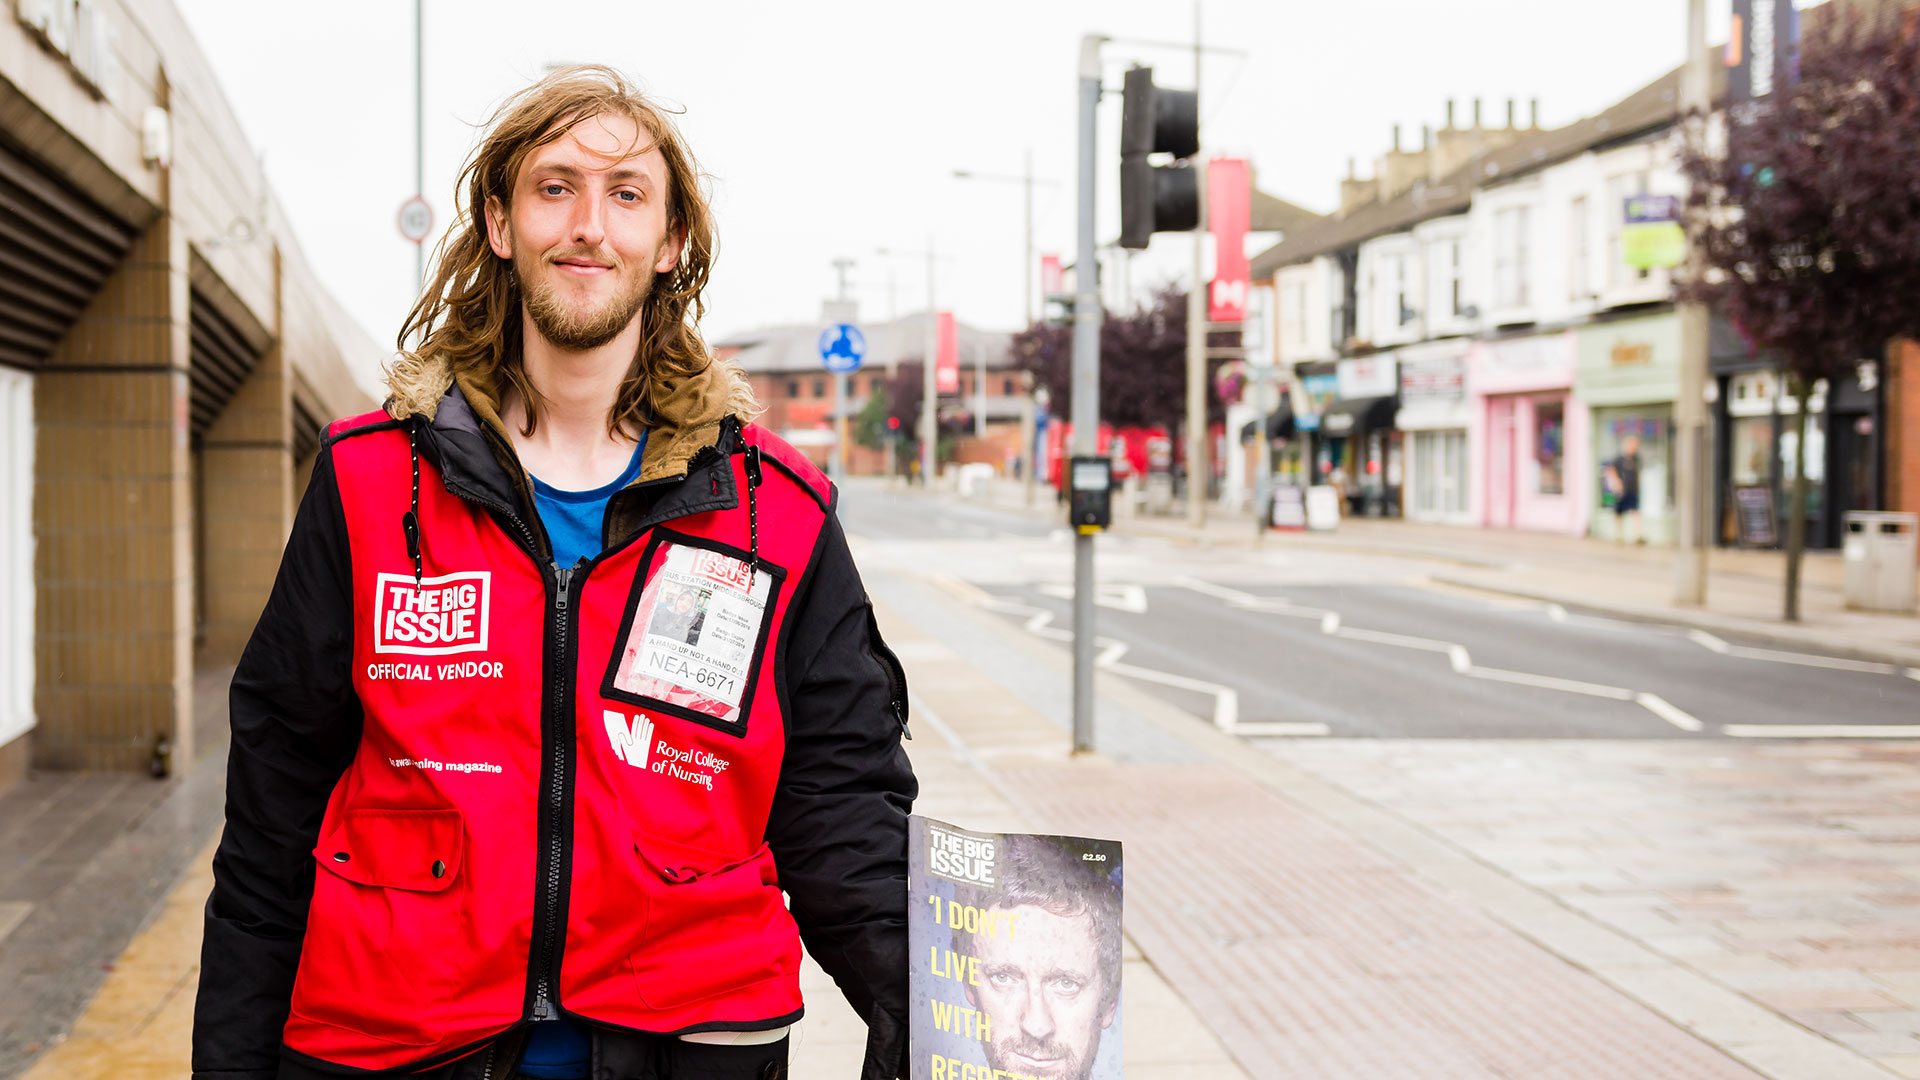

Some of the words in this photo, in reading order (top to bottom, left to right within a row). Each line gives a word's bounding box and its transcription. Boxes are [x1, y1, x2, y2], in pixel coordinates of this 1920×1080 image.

[664, 570, 680, 580] BUS
[681, 575, 712, 589] STATION
[699, 558, 747, 587] ISSUE
[389, 586, 441, 613] THE
[441, 584, 477, 611] BIG
[384, 608, 476, 643] ISSUE
[367, 663, 432, 681] OFFICIAL
[437, 661, 504, 681] VENDOR
[655, 640, 677, 651] HAND
[678, 646, 689, 655] UP
[689, 650, 705, 660] NOT
[705, 656, 711, 664] A
[712, 658, 731, 671] HAND
[649, 651, 735, 695] NEA-6671
[445, 762, 502, 774] magazine
[656, 740, 694, 763] Royal
[695, 751, 730, 774] College
[652, 760, 668, 774] of
[668, 763, 713, 791] Nursing
[930, 829, 963, 856] THE
[963, 839, 995, 861] BIG
[1082, 853, 1107, 862] £2.50
[930, 846, 995, 883] ISSUE
[949, 901, 1020, 941] DON'T
[931, 946, 982, 987] LIVE
[931, 999, 992, 1043] WITH
